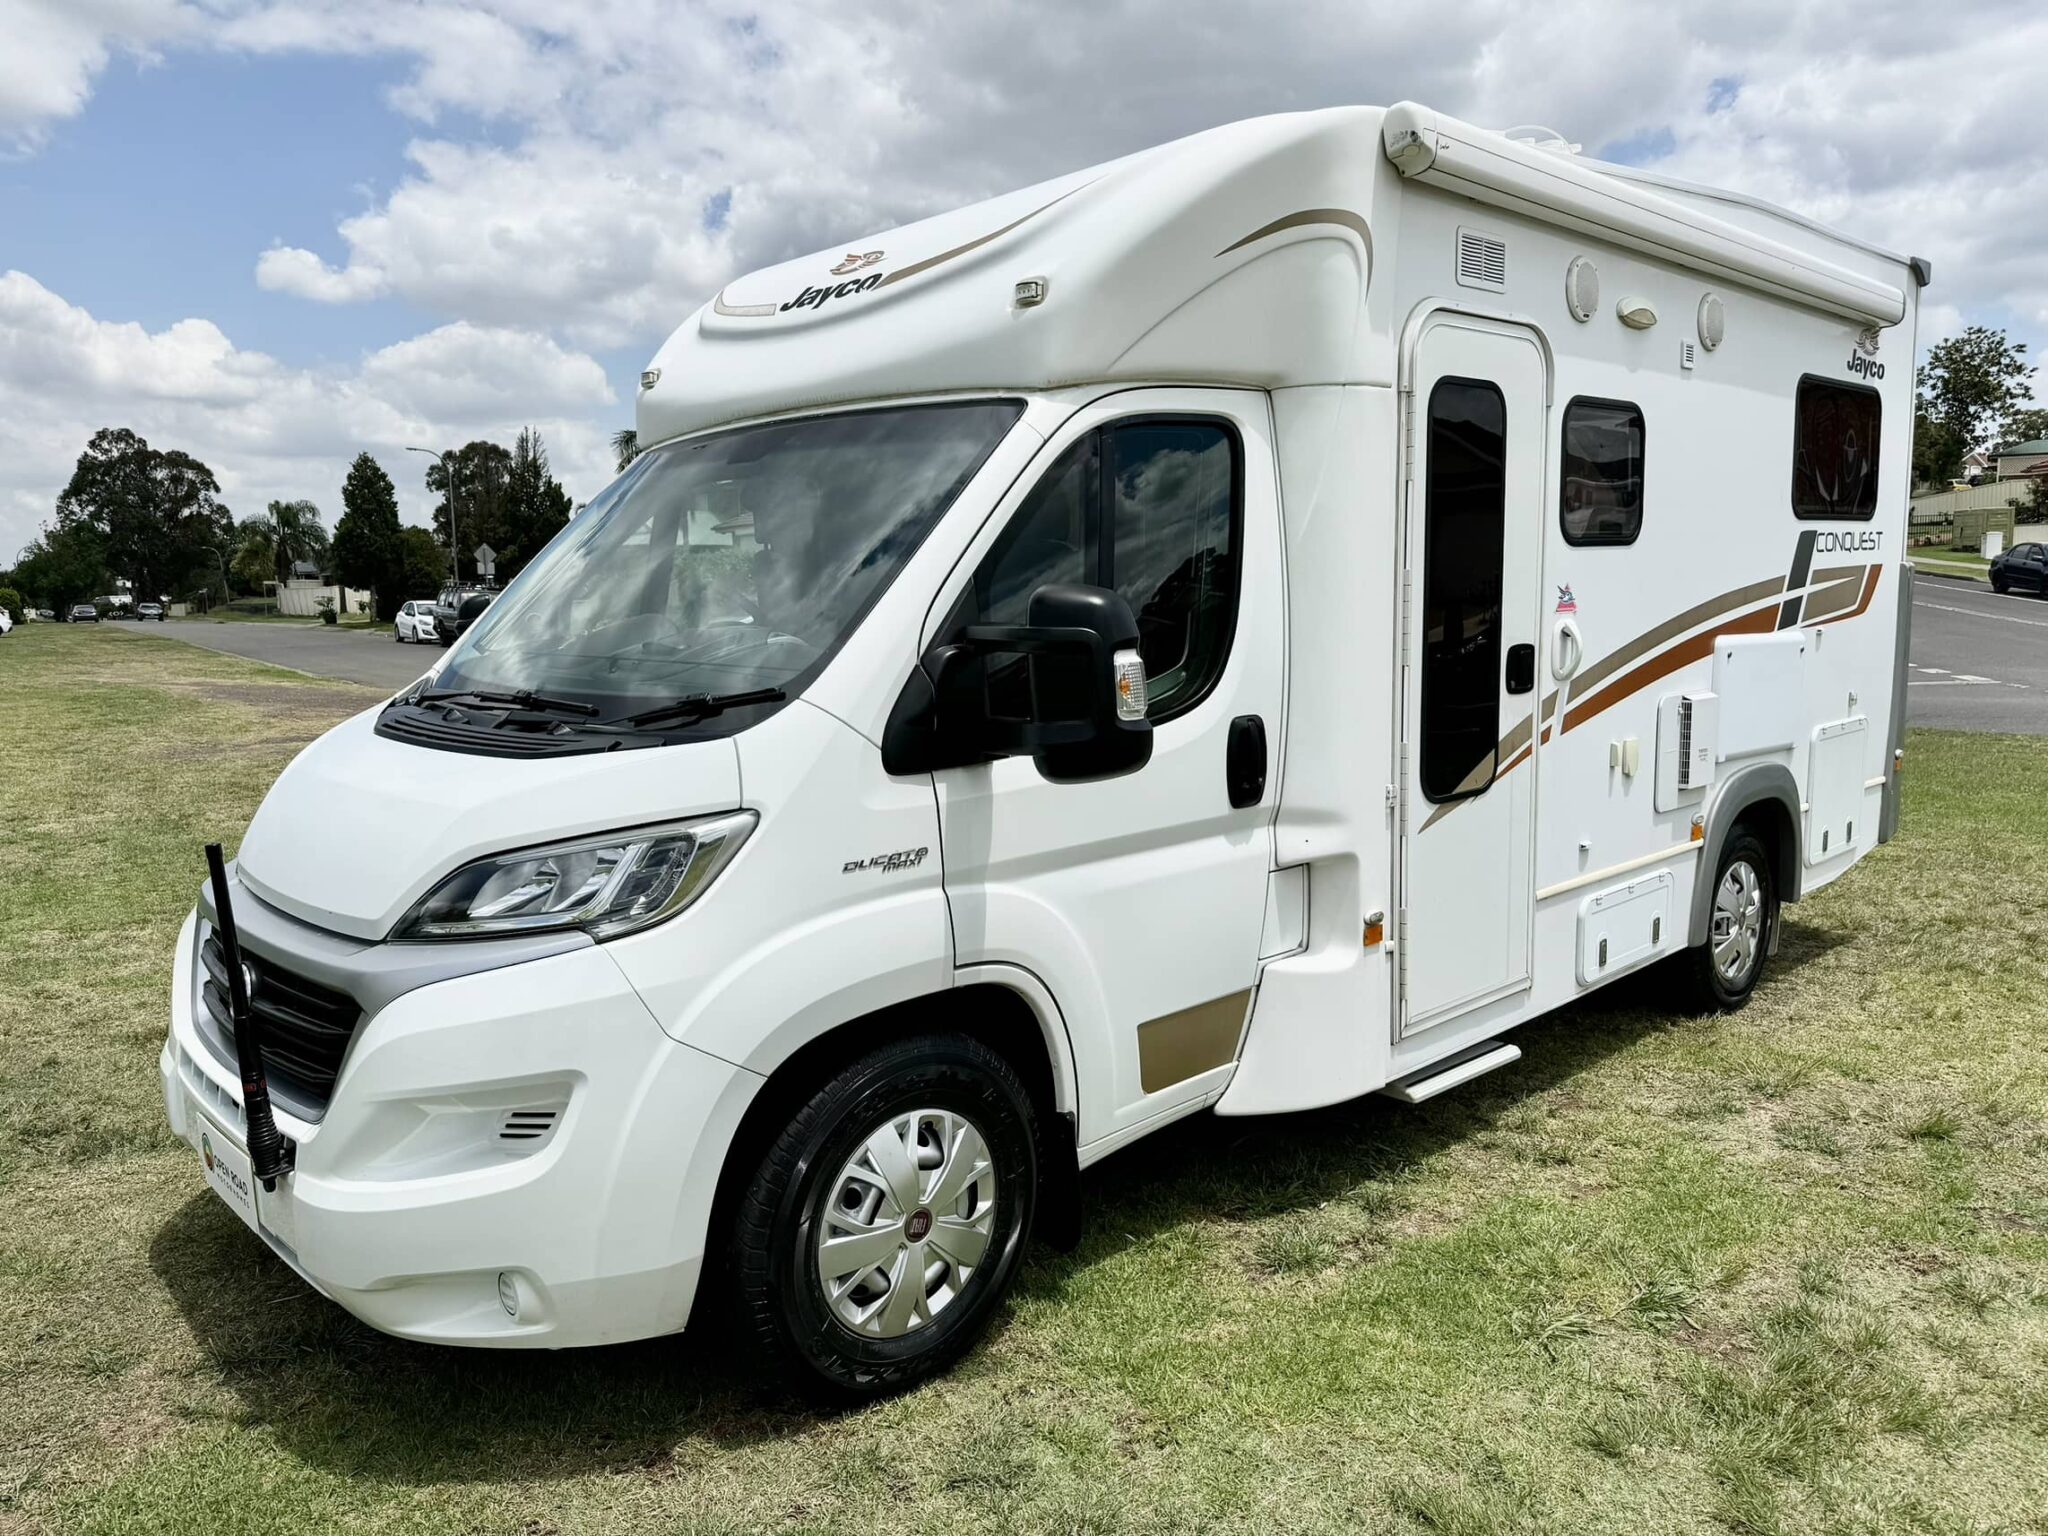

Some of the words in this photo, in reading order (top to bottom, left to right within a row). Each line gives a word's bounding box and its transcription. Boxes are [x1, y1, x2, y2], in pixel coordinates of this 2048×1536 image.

[779, 272, 883, 312] Jayco
[1847, 348, 1885, 380] Jayco
[1816, 531, 1883, 553] CONQUEST
[231, 1171, 248, 1195] ROAD
